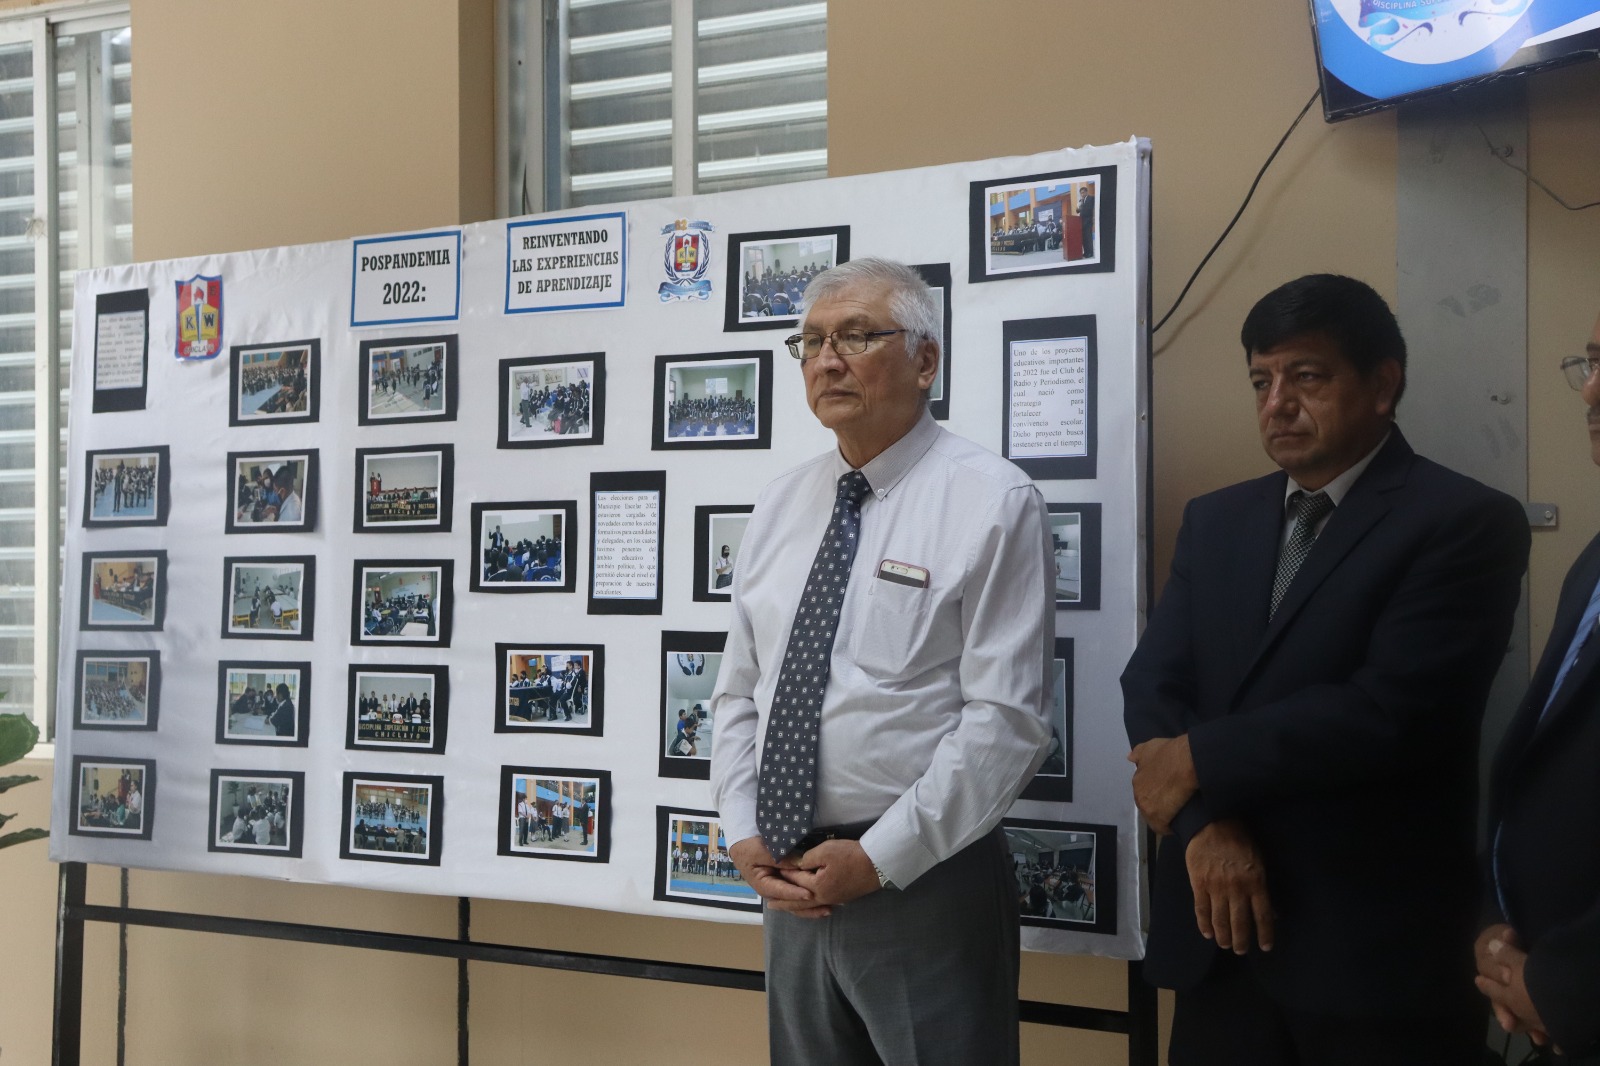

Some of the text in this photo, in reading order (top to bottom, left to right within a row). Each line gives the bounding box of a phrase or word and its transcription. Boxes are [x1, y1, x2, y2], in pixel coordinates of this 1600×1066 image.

[522, 229, 608, 250] REINVENTANDO
[361, 249, 450, 271] POSPANDEMIA
[512, 251, 619, 272] LAS EXPERIENCIAS
[383, 280, 426, 305] 2022:
[518, 275, 612, 294] DE APRENDIZAJE
[186, 314, 214, 329] K W
[1055, 347, 1084, 355] proyectos
[1049, 357, 1084, 365] importantes
[1036, 429, 1061, 438] proyecto
